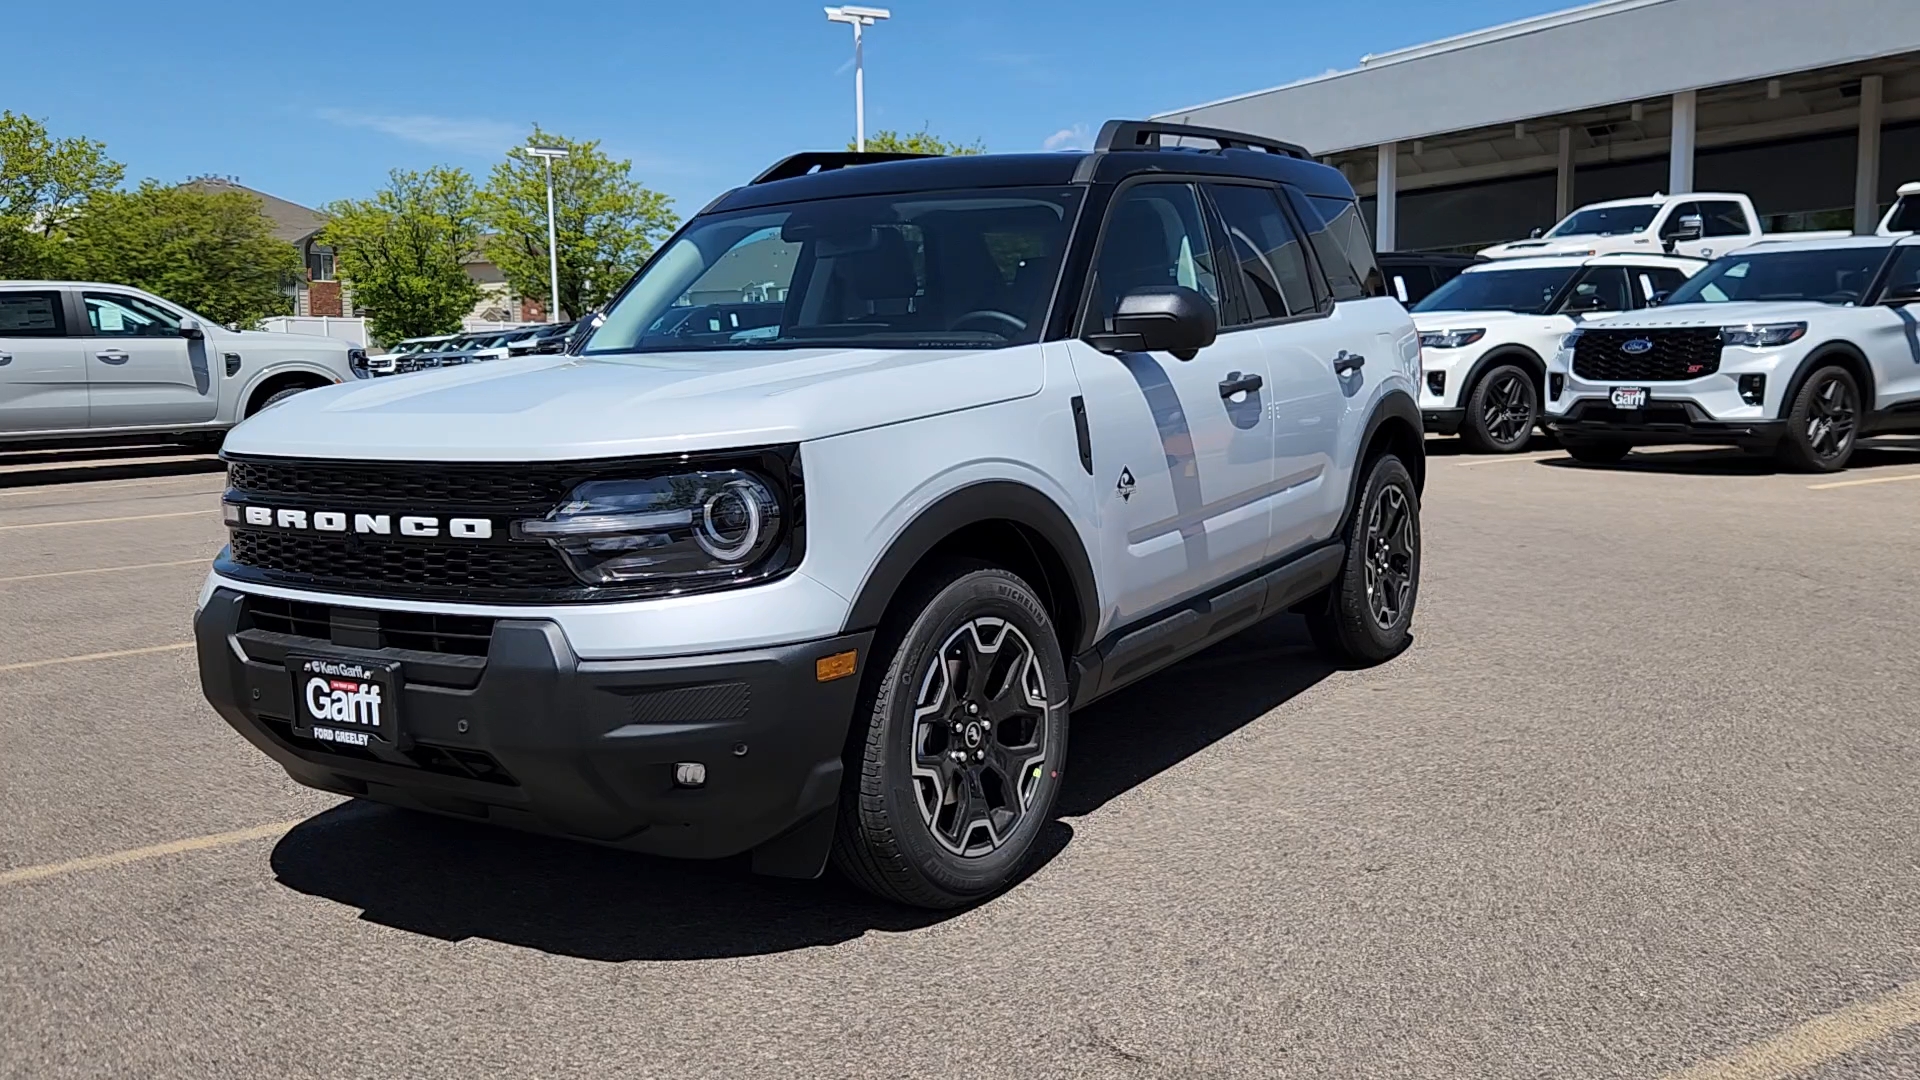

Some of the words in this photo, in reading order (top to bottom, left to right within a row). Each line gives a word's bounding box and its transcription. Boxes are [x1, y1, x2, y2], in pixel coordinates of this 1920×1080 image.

[1611, 390, 1646, 405] Garff
[245, 506, 493, 539] BRONCO
[998, 585, 1044, 623] MICHELIN
[320, 662, 339, 675] Ken
[340, 664, 363, 678] Garff
[306, 677, 381, 726] Garff
[313, 727, 334, 741] FORD
[335, 730, 368, 746] GREELEY
